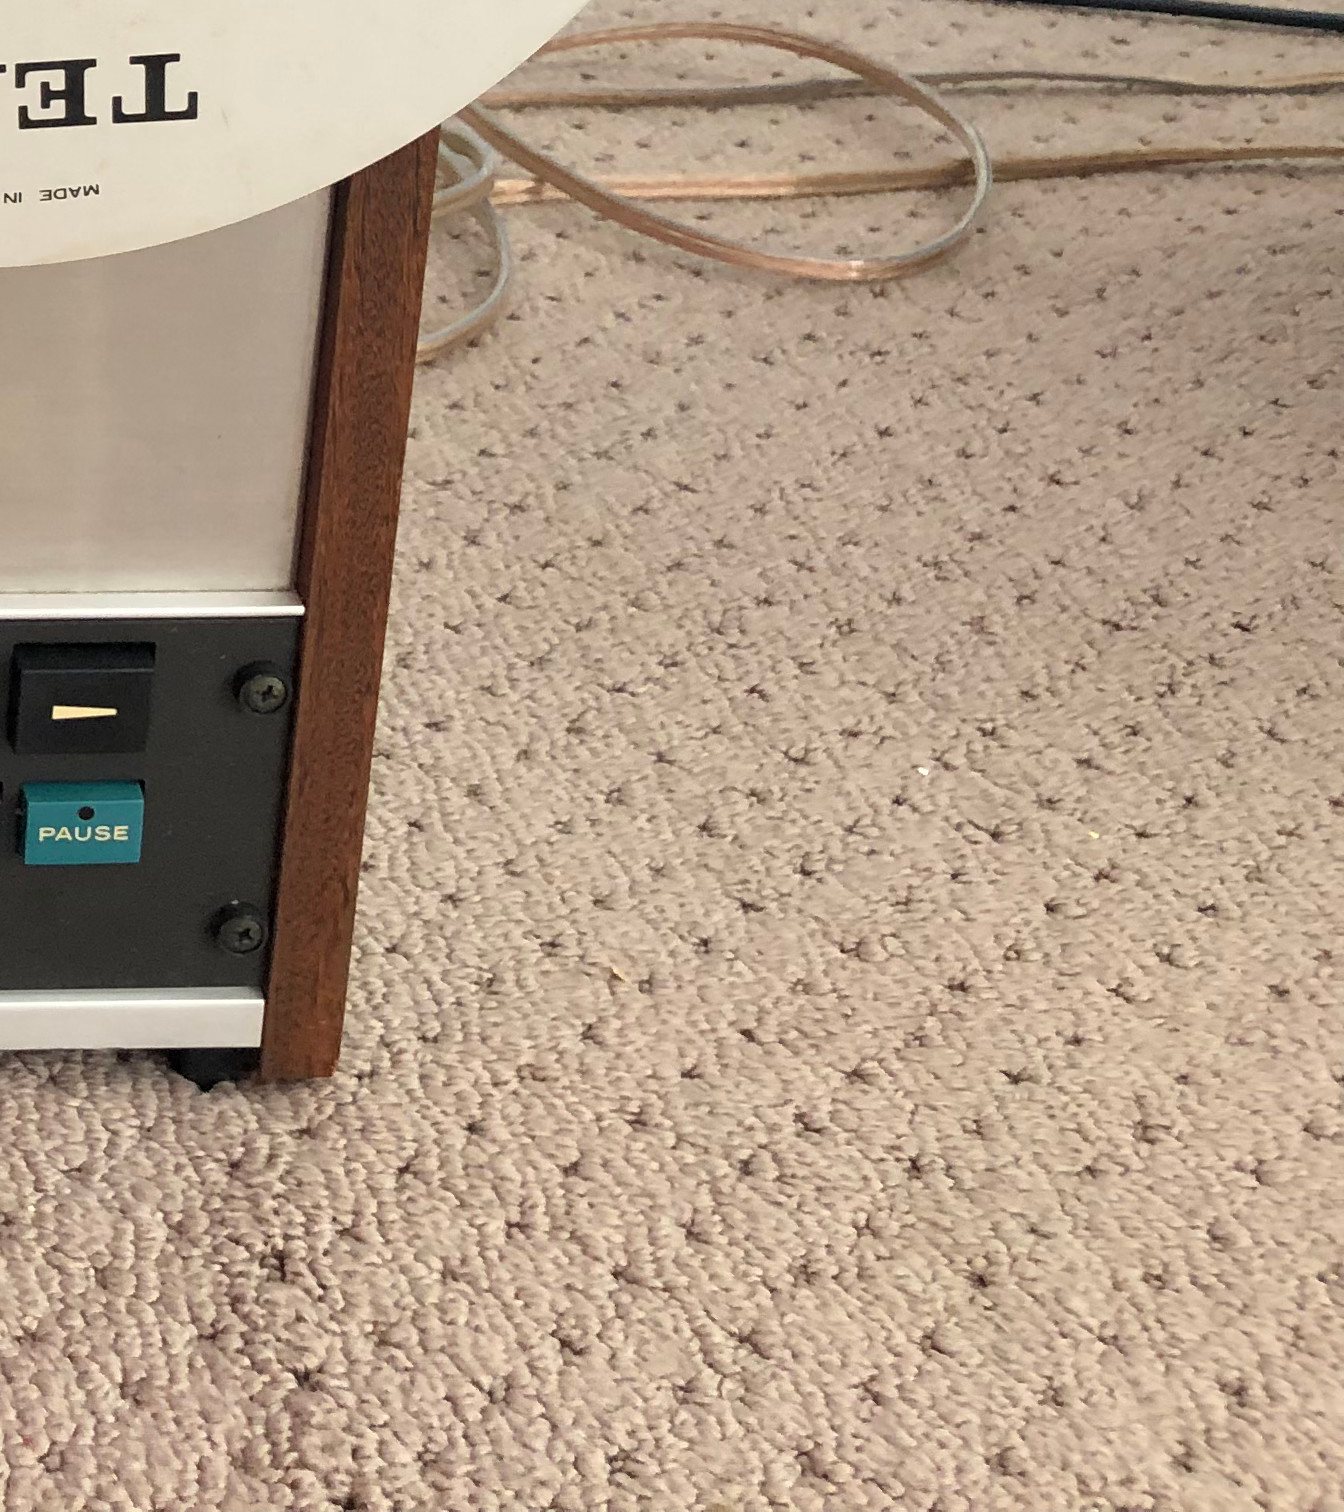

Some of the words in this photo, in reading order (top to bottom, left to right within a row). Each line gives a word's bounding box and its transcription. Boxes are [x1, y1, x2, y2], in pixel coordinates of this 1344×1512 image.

[4, 192, 22, 203] IN
[40, 184, 99, 201] MADE
[39, 826, 128, 841] PAUSE
